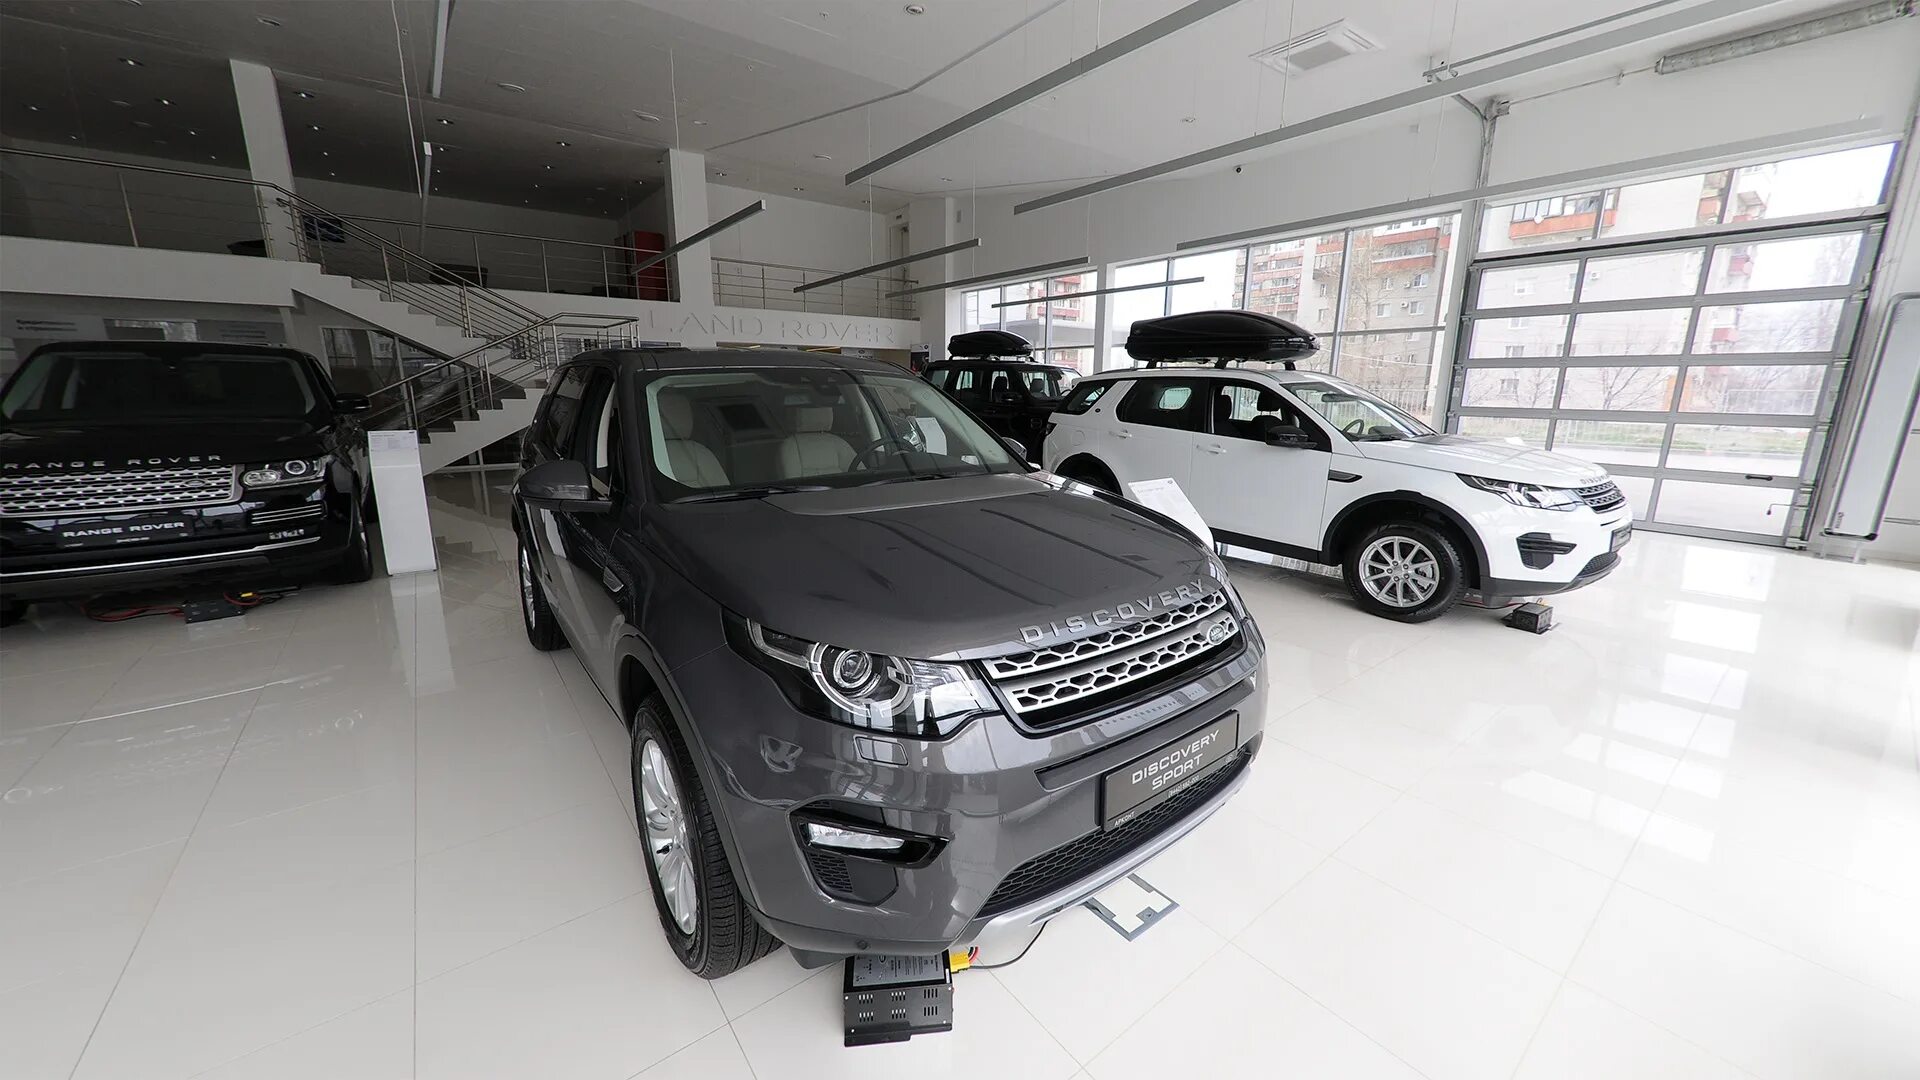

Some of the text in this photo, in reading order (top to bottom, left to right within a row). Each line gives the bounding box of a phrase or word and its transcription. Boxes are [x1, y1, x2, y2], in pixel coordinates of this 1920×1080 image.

[649, 309, 895, 344] LAND ROVER
[3, 454, 222, 470] RANGE ROVER
[62, 521, 186, 538] RANGE ROVER
[1019, 578, 1204, 644] DISCOVERY
[1131, 729, 1220, 785] DISCOVERY
[1151, 752, 1204, 791] SPORT
